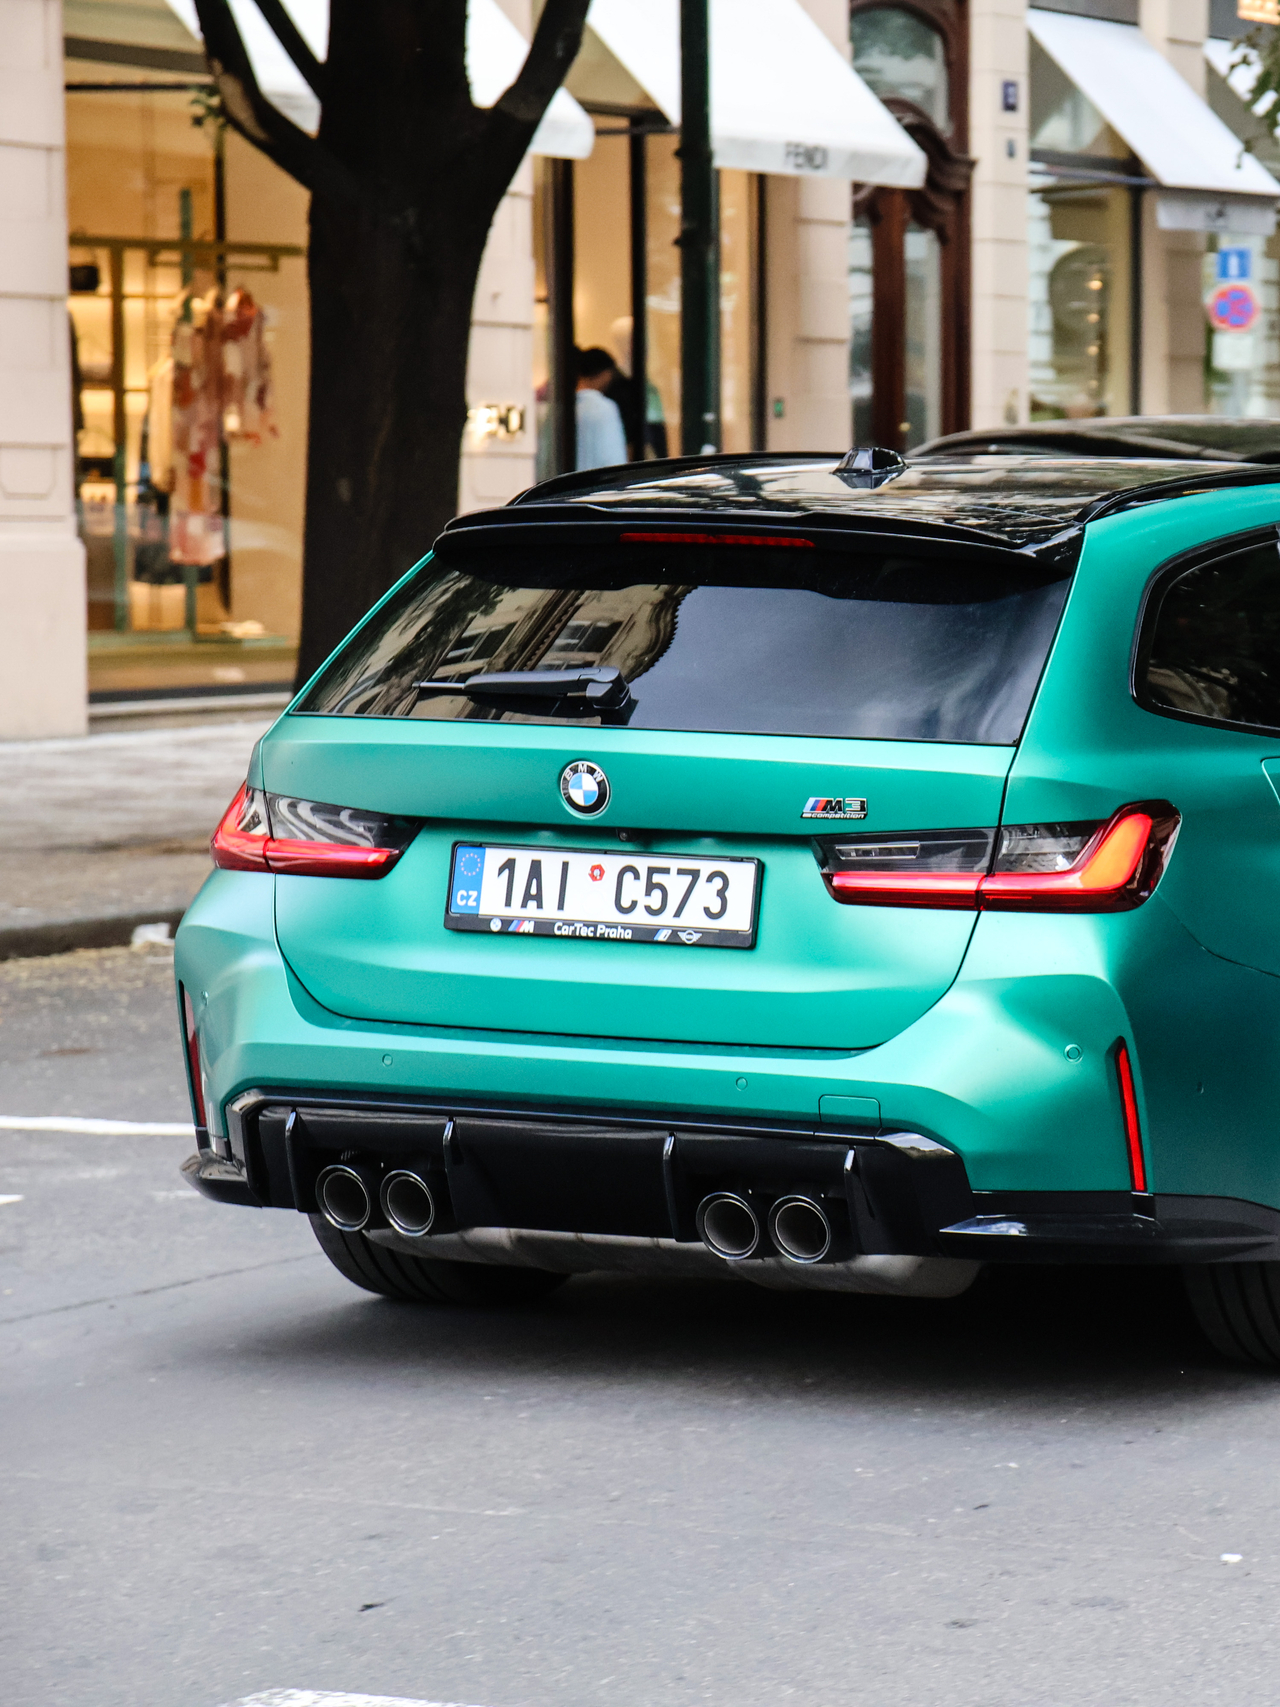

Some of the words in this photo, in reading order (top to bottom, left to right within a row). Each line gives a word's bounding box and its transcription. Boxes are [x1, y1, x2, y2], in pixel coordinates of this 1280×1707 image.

[564, 763, 604, 782] BMW
[456, 889, 478, 907] CZ
[614, 864, 730, 920] C573
[554, 922, 594, 937] CarTec
[596, 924, 633, 939] Praha
